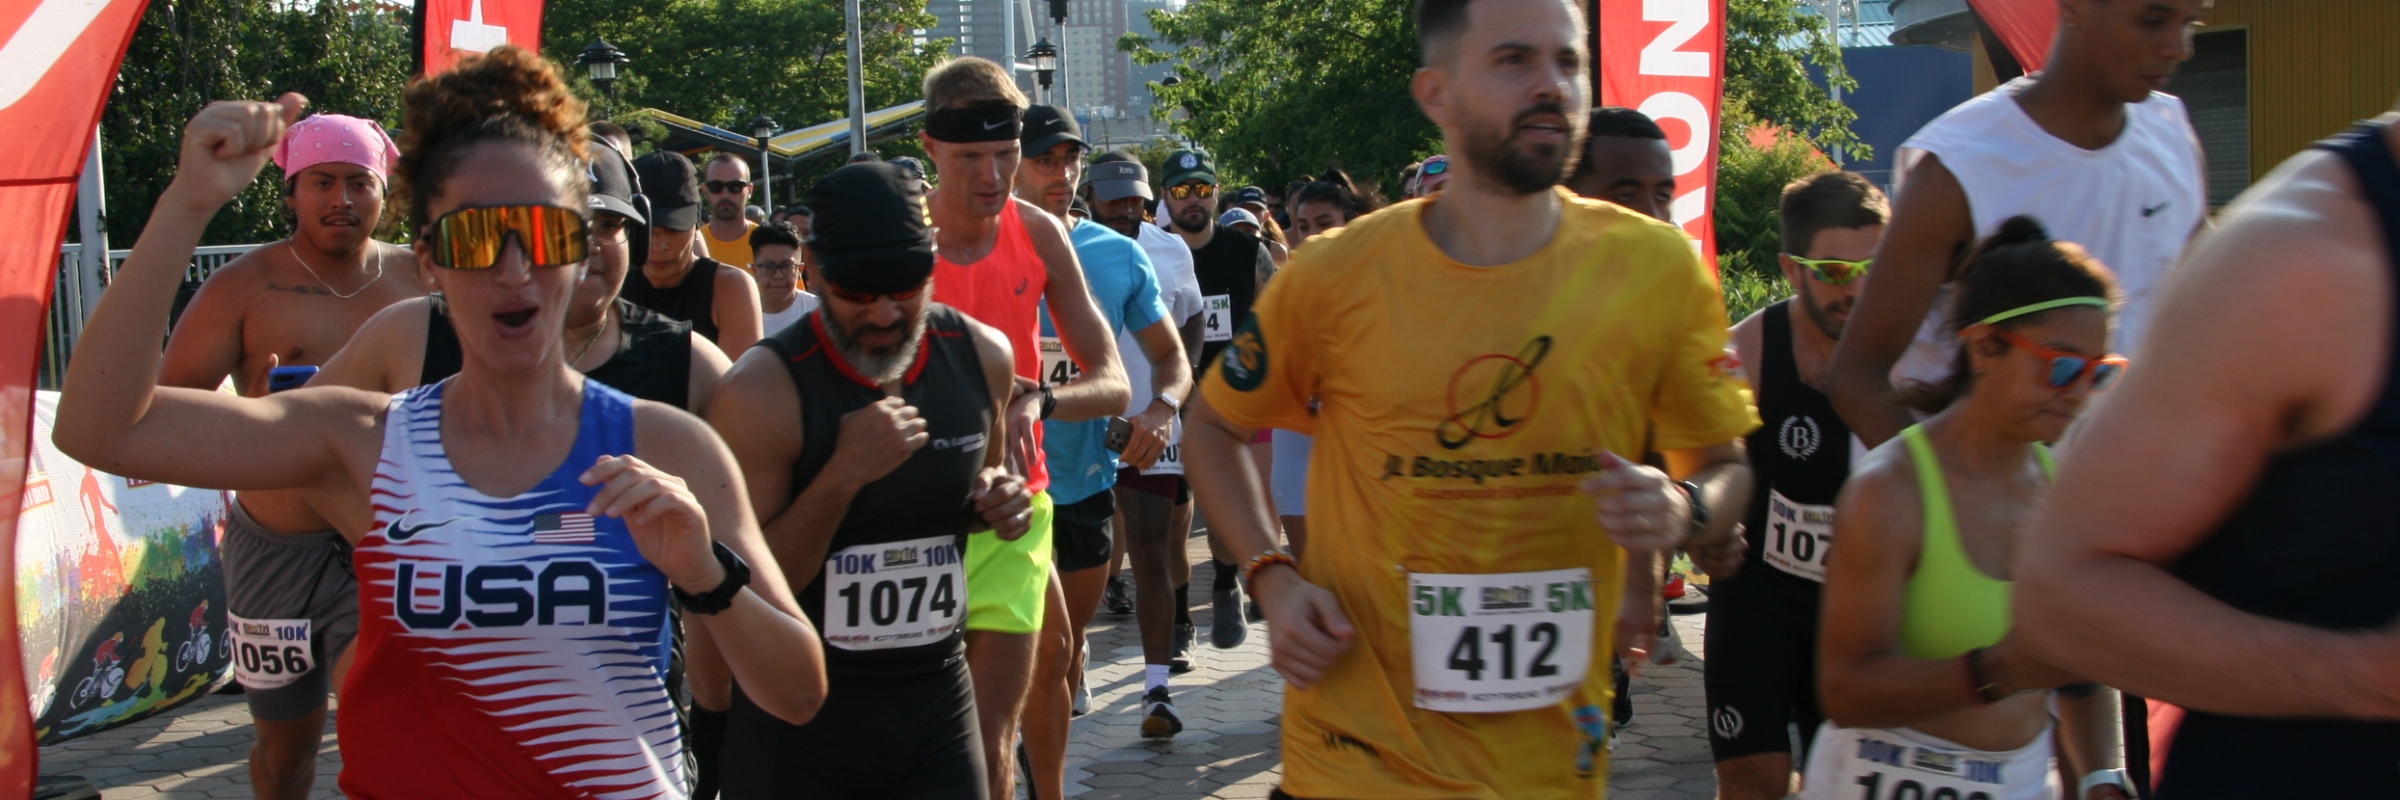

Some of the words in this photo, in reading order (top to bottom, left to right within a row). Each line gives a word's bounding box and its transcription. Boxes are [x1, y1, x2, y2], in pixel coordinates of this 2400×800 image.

[1212, 298, 1230, 310] 5K
[1206, 313, 1219, 331] 4
[1793, 427, 1809, 448] B
[1412, 456, 1526, 485] Bosque
[831, 553, 877, 575] 10K
[923, 544, 958, 568] 10K
[1773, 522, 1833, 567] 107
[396, 560, 606, 630] USA
[838, 572, 957, 627] 1074
[1414, 585, 1466, 616] 5K
[1547, 580, 1594, 613] 5K
[275, 625, 308, 641] 10K
[231, 637, 308, 675] 1056
[1447, 621, 1561, 681] 412
